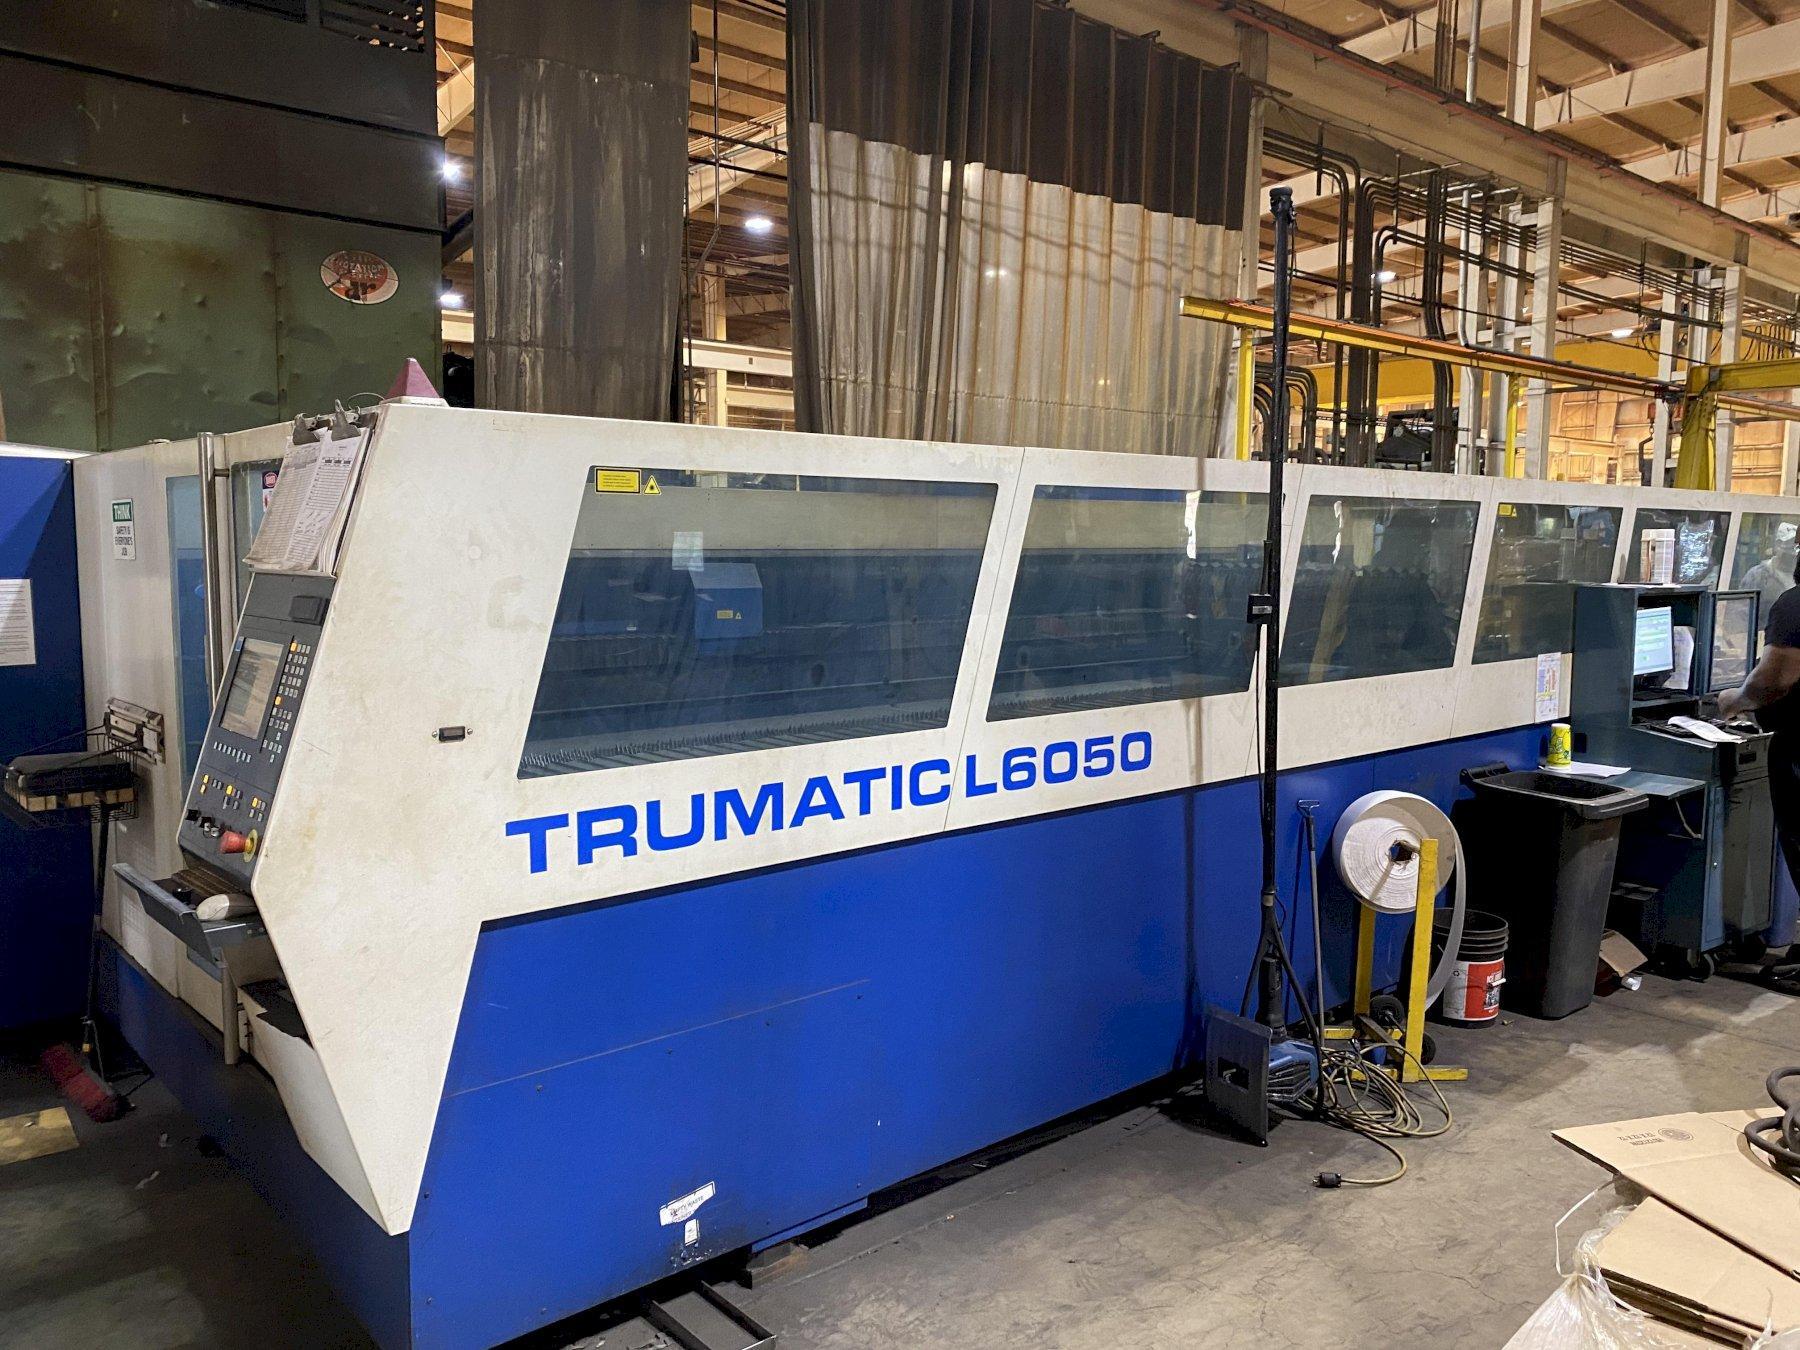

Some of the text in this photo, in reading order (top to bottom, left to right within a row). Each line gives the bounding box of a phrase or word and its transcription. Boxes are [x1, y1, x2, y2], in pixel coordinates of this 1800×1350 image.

[113, 504, 130, 520] THINK
[505, 731, 1153, 874] TRUMATIC L6050
